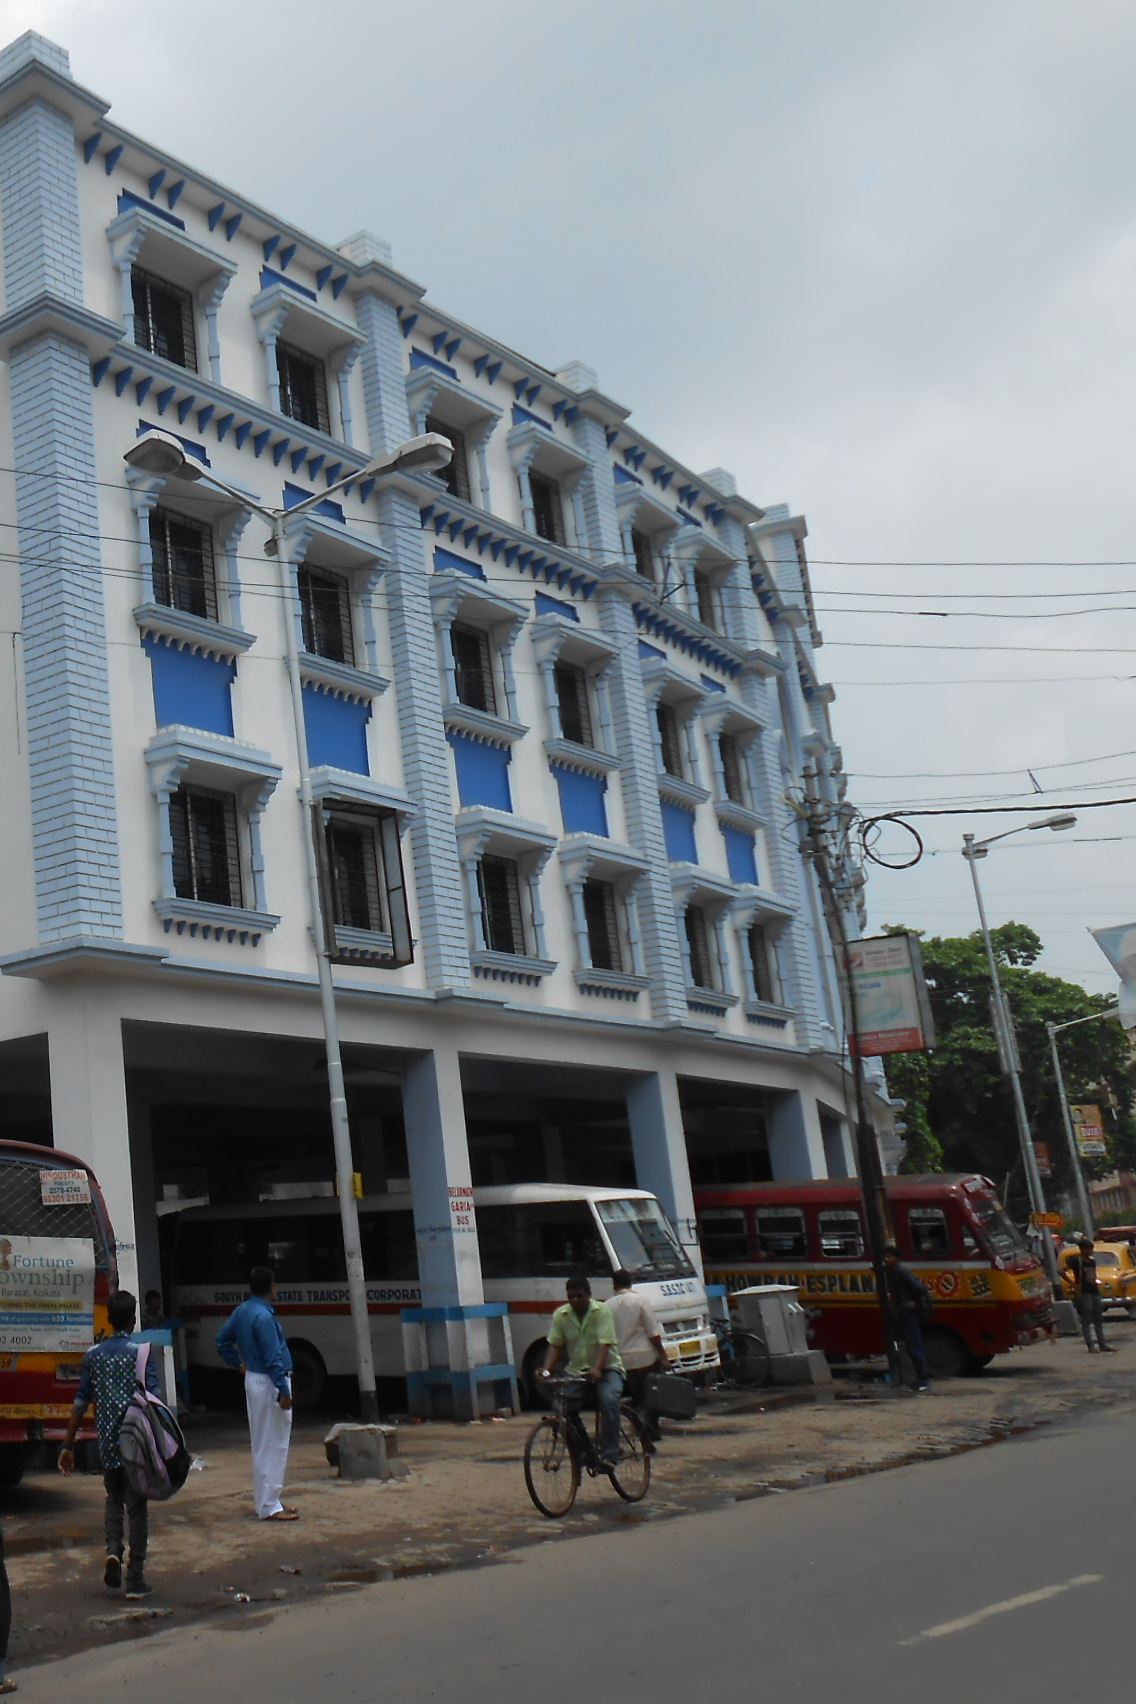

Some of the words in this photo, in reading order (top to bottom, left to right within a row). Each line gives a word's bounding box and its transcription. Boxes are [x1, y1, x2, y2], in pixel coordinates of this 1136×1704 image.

[39, 1171, 86, 1181] HINDUSTHAN
[451, 1201, 472, 1212] GARIA
[456, 1215, 470, 1225] BUS
[12, 1254, 75, 1269] Fortune
[806, 1273, 877, 1294] ESPLAN
[1, 1287, 31, 1298] Barasat,
[33, 1288, 61, 1298] Kolkata
[214, 1291, 242, 1303] SOUTH
[277, 1289, 304, 1302] STATE
[307, 1288, 351, 1302] TRANSPO
[366, 1288, 423, 1301] CORPORAT
[24, 1302, 37, 1310] THE
[38, 1302, 58, 1310] FINAL
[58, 1302, 81, 1311] PHASE
[10, 1335, 33, 1346] 4002
